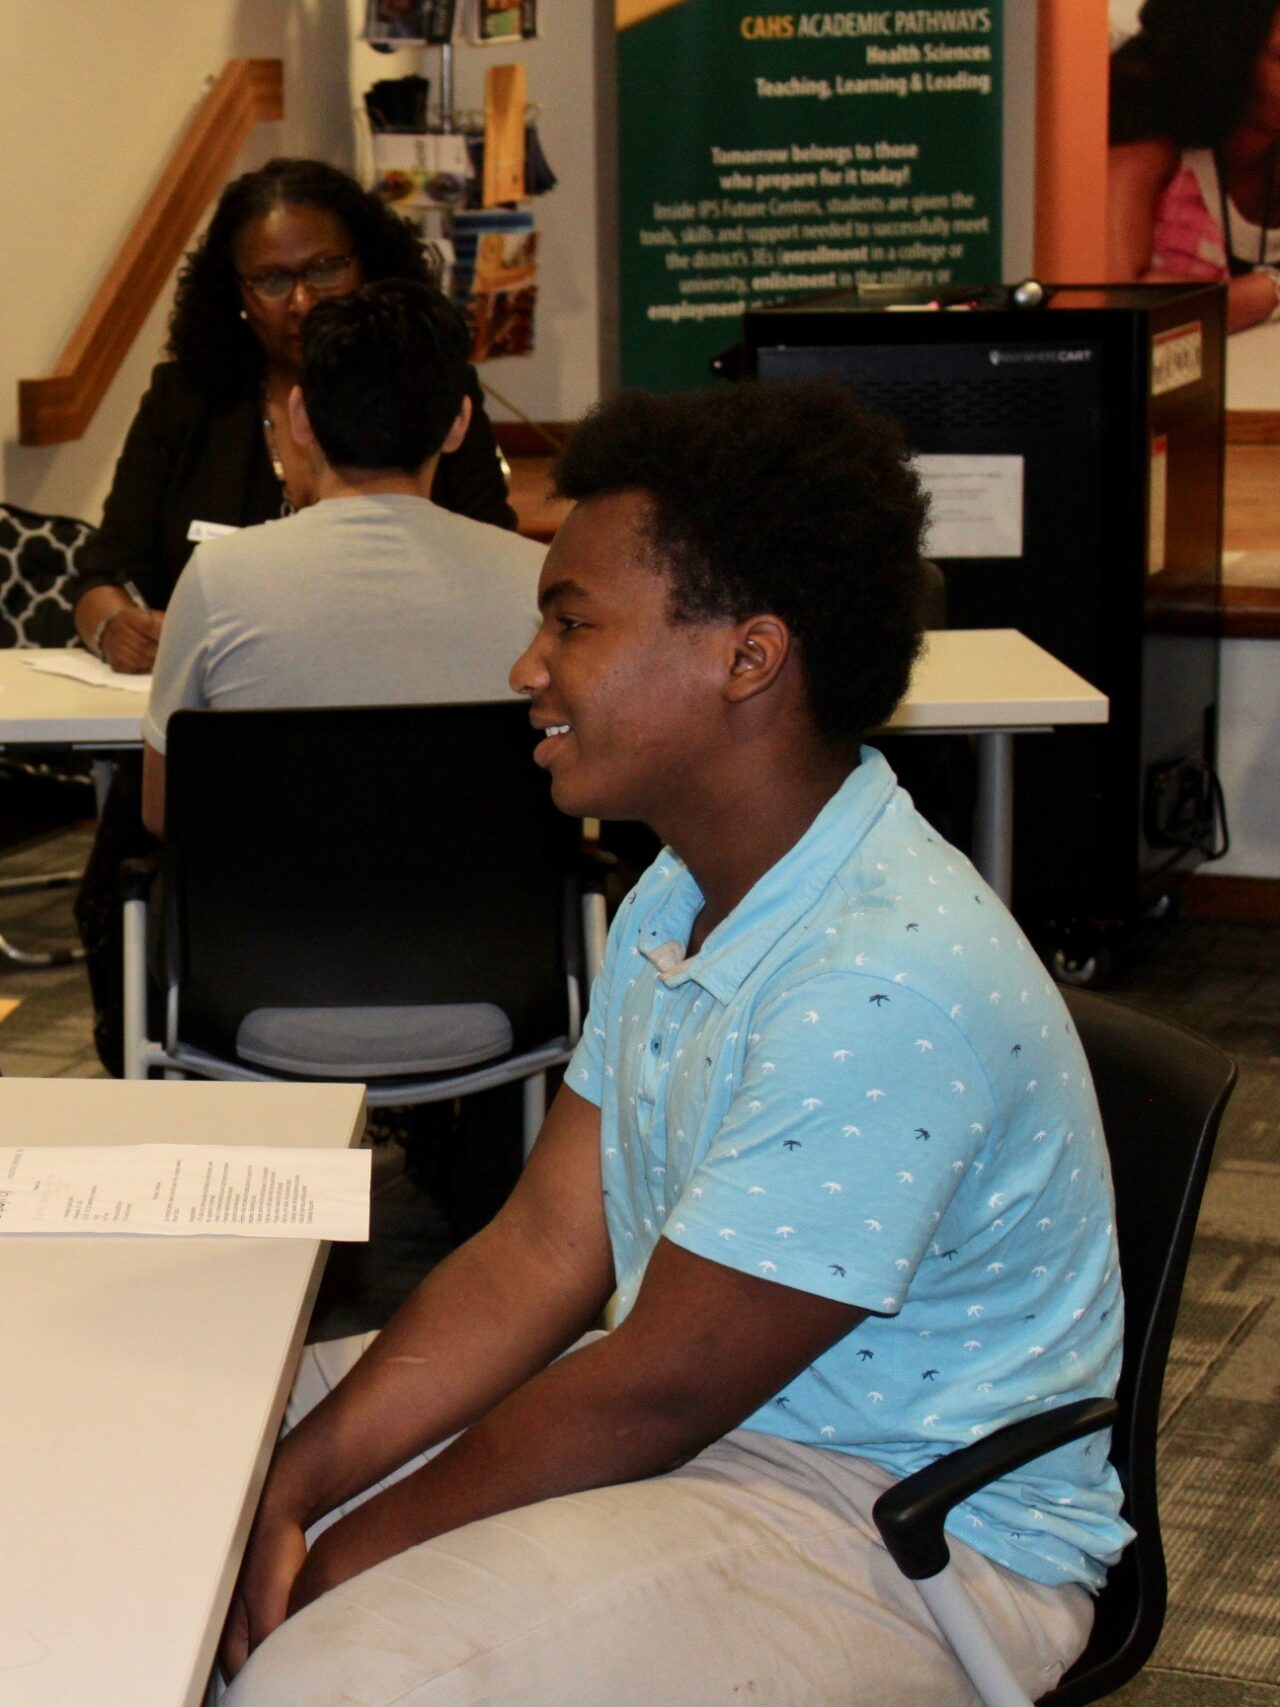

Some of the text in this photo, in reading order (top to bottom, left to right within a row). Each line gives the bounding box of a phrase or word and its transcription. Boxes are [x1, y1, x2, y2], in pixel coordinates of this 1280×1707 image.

[740, 8, 992, 40] CAHS ACADEMIC PATHWAYS
[866, 42, 992, 65] Health Sciences
[755, 71, 992, 100] Teaching, Learning & Leading
[711, 141, 918, 165] Tomorrow belongs to those
[720, 165, 911, 192] who prepare for it today!
[653, 202, 695, 220] Inside
[722, 199, 767, 217] Future
[825, 196, 885, 214] students
[887, 197, 908, 212] are
[911, 195, 949, 216] given
[951, 190, 975, 209] the
[718, 224, 744, 242] and
[746, 224, 799, 244] support
[801, 221, 853, 240] needed
[855, 221, 869, 237] to
[665, 253, 690, 270] the
[751, 271, 837, 291] enlistment
[647, 299, 746, 323] employment
